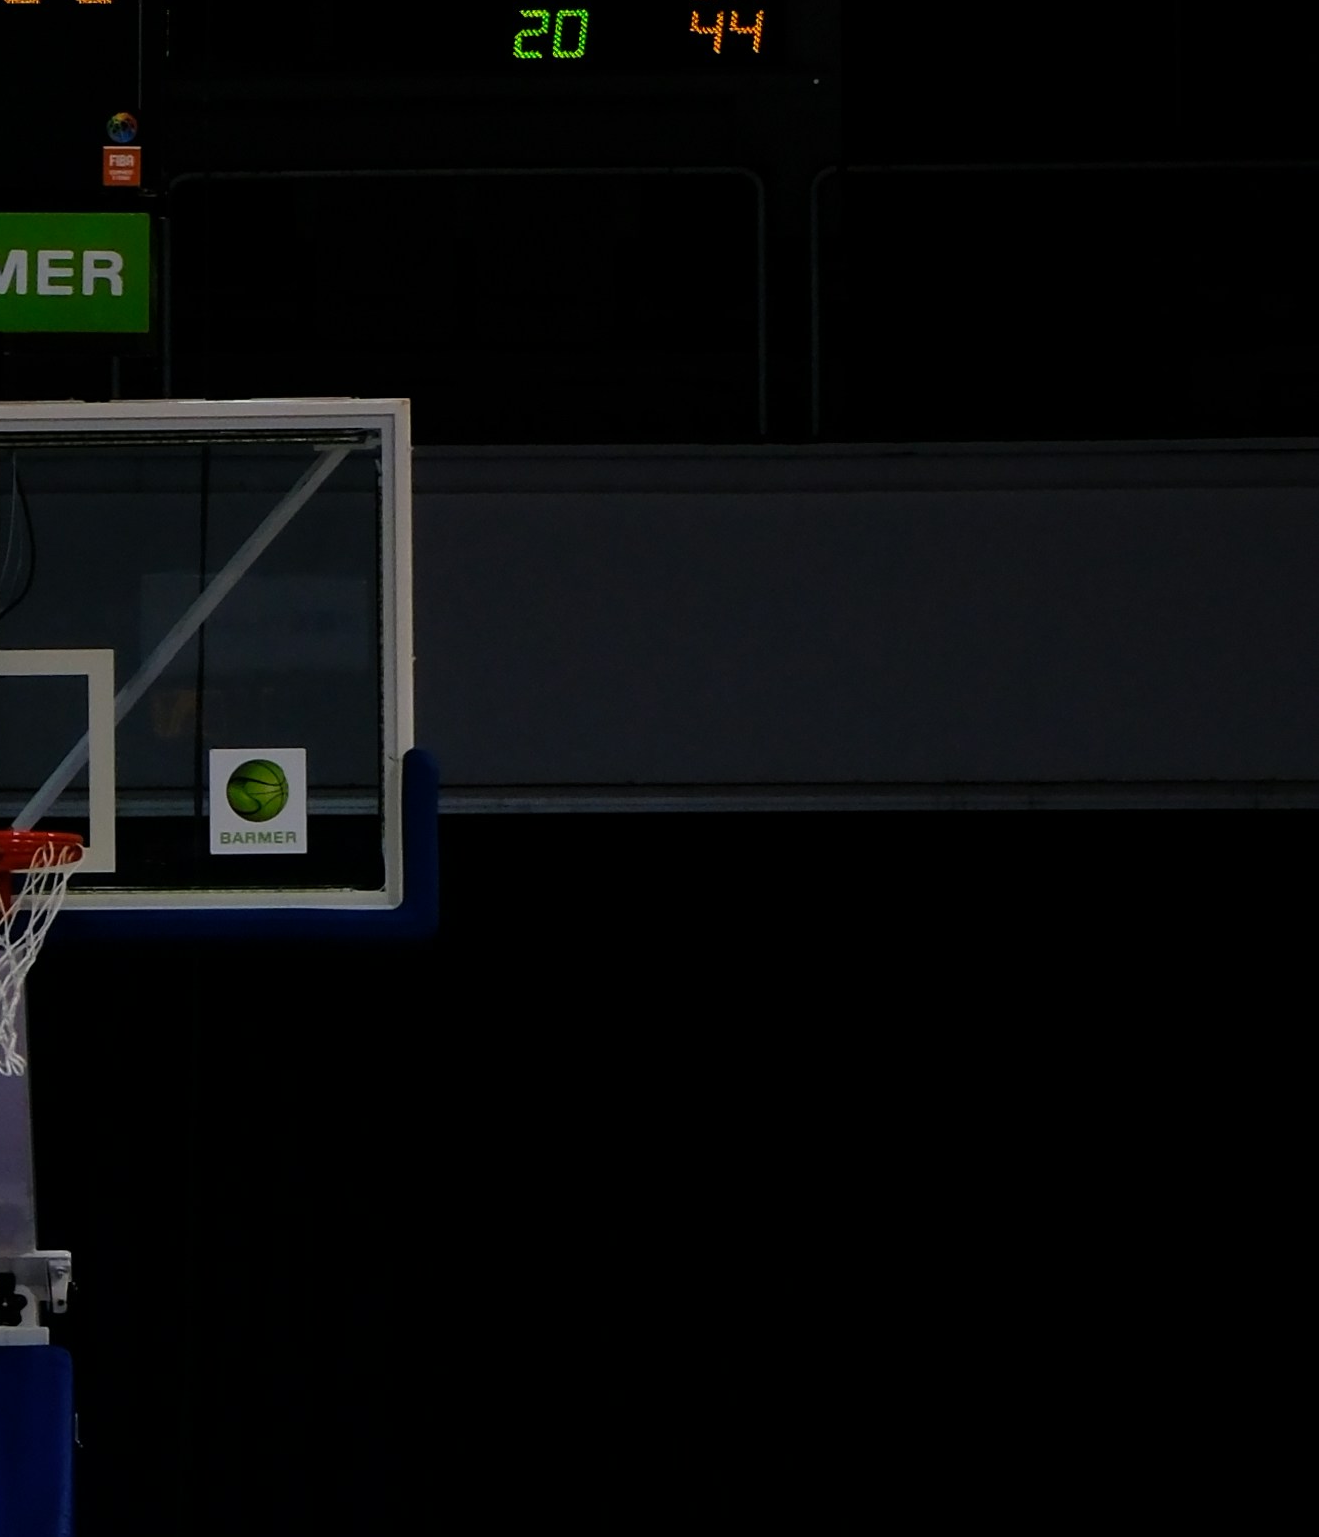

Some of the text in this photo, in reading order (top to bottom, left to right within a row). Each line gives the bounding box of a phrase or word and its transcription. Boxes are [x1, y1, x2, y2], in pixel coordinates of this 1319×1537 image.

[513, 9, 764, 59] 20 44
[220, 831, 297, 845] BARMER
